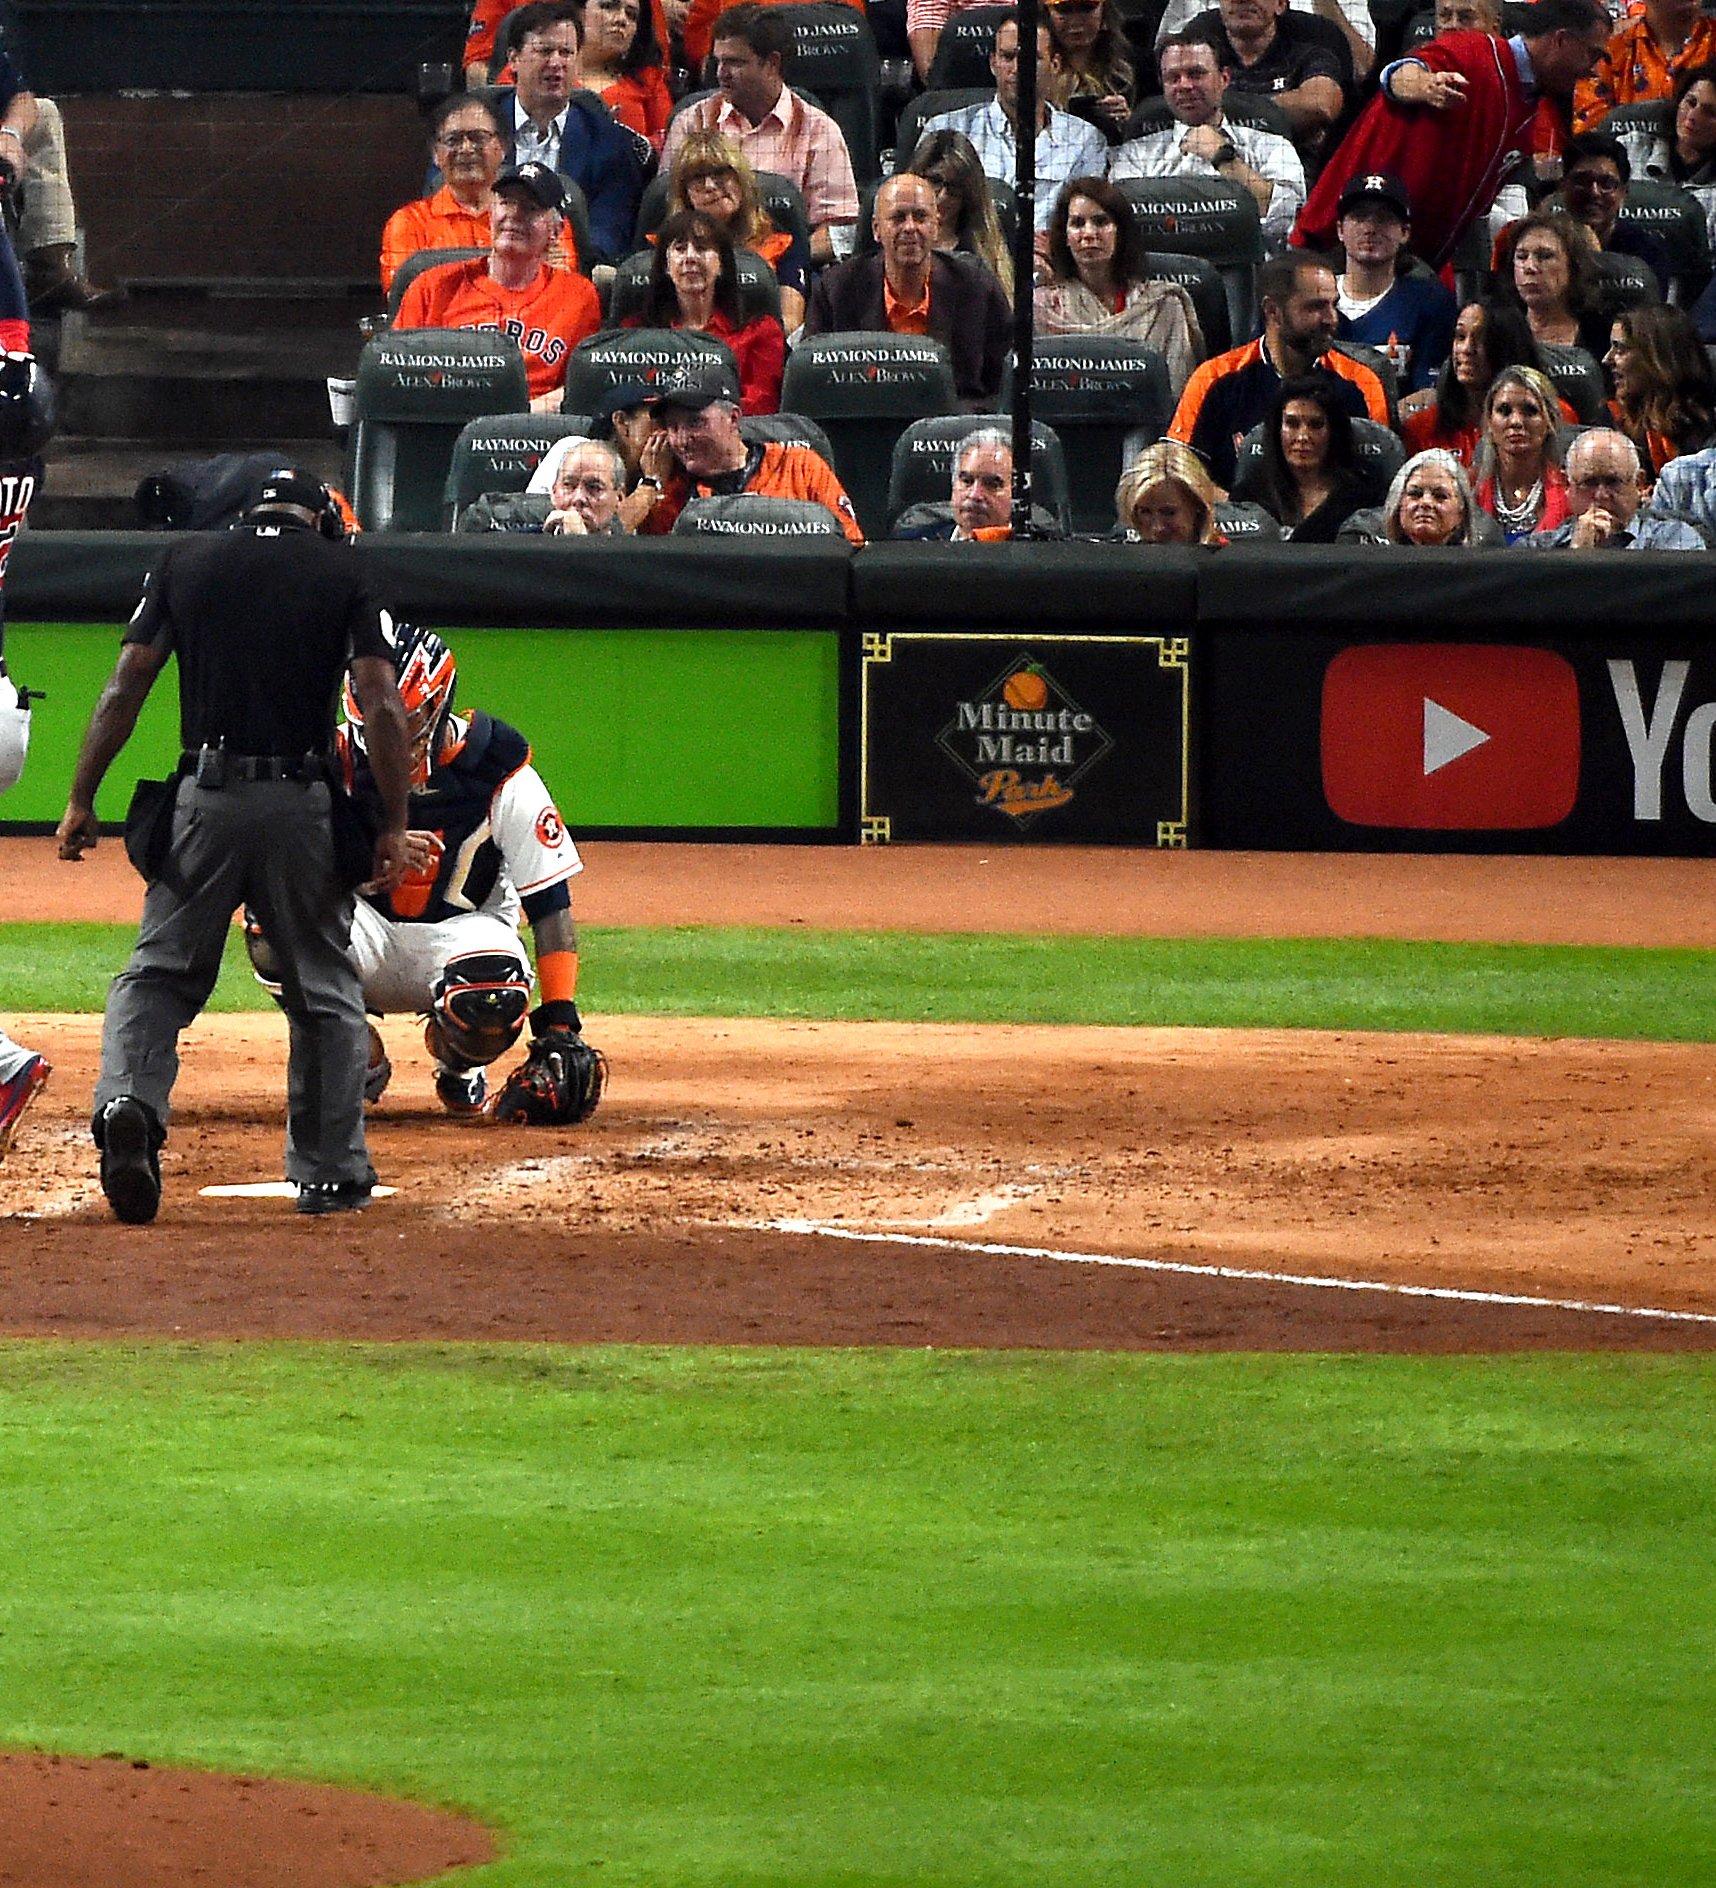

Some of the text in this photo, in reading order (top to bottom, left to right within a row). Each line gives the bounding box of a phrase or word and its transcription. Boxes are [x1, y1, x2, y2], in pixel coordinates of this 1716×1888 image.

[809, 23, 859, 37] JAMES
[1131, 199, 1237, 215] YMOND JAMES
[1631, 207, 1682, 220] JAMES
[380, 352, 506, 368] RAYMOND JAMES
[590, 350, 723, 365] RAYMOND JAMES
[812, 349, 939, 364] RAYMOND JAMES
[1095, 358, 1147, 373] JAMES
[441, 374, 494, 389] BROWN
[875, 368, 928, 383] BROWN
[1081, 376, 1134, 391] BROWN
[471, 438, 550, 451] RAYMOND
[696, 517, 831, 535] RAYMOND JAMES
[956, 701, 1093, 732] Minute
[975, 735, 1075, 765] Maid
[976, 769, 1074, 816] Park
